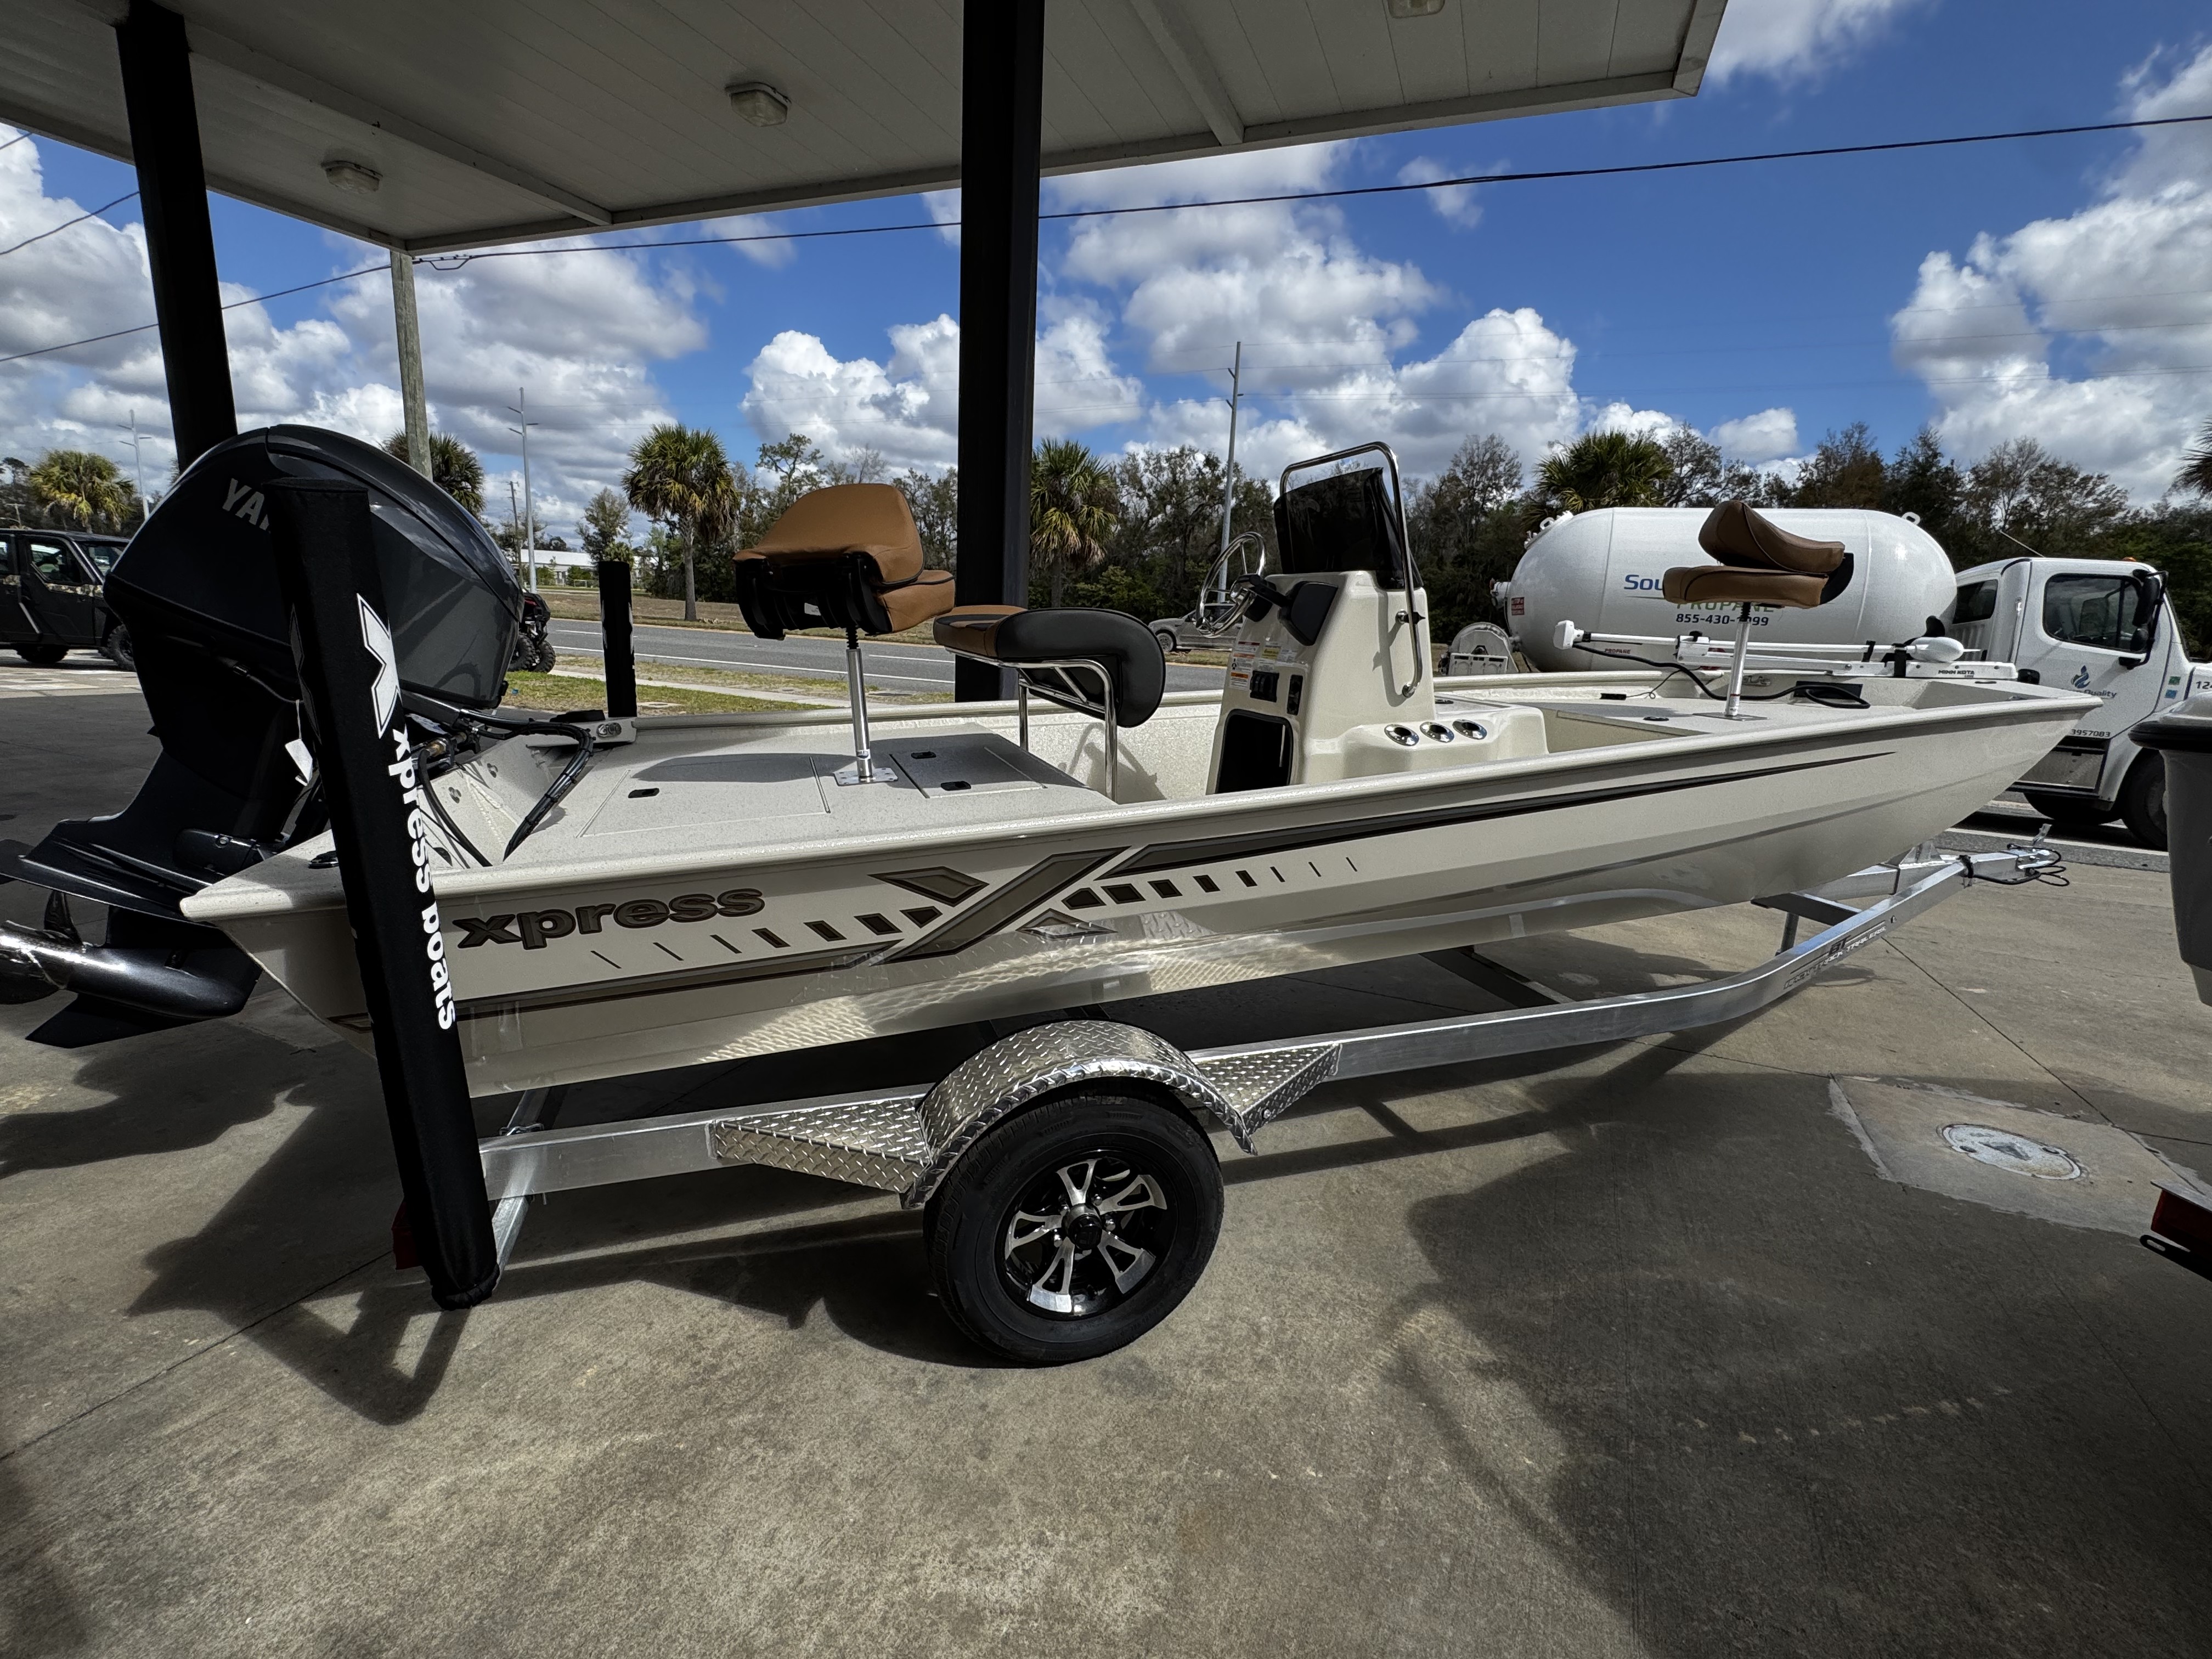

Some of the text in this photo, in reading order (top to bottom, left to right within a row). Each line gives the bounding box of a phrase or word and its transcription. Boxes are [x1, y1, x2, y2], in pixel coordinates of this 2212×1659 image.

[222, 478, 271, 533] YA
[1676, 614, 1769, 625] 855-430-99
[2070, 729, 2111, 737] 3957083
[452, 889, 765, 950] xpress
